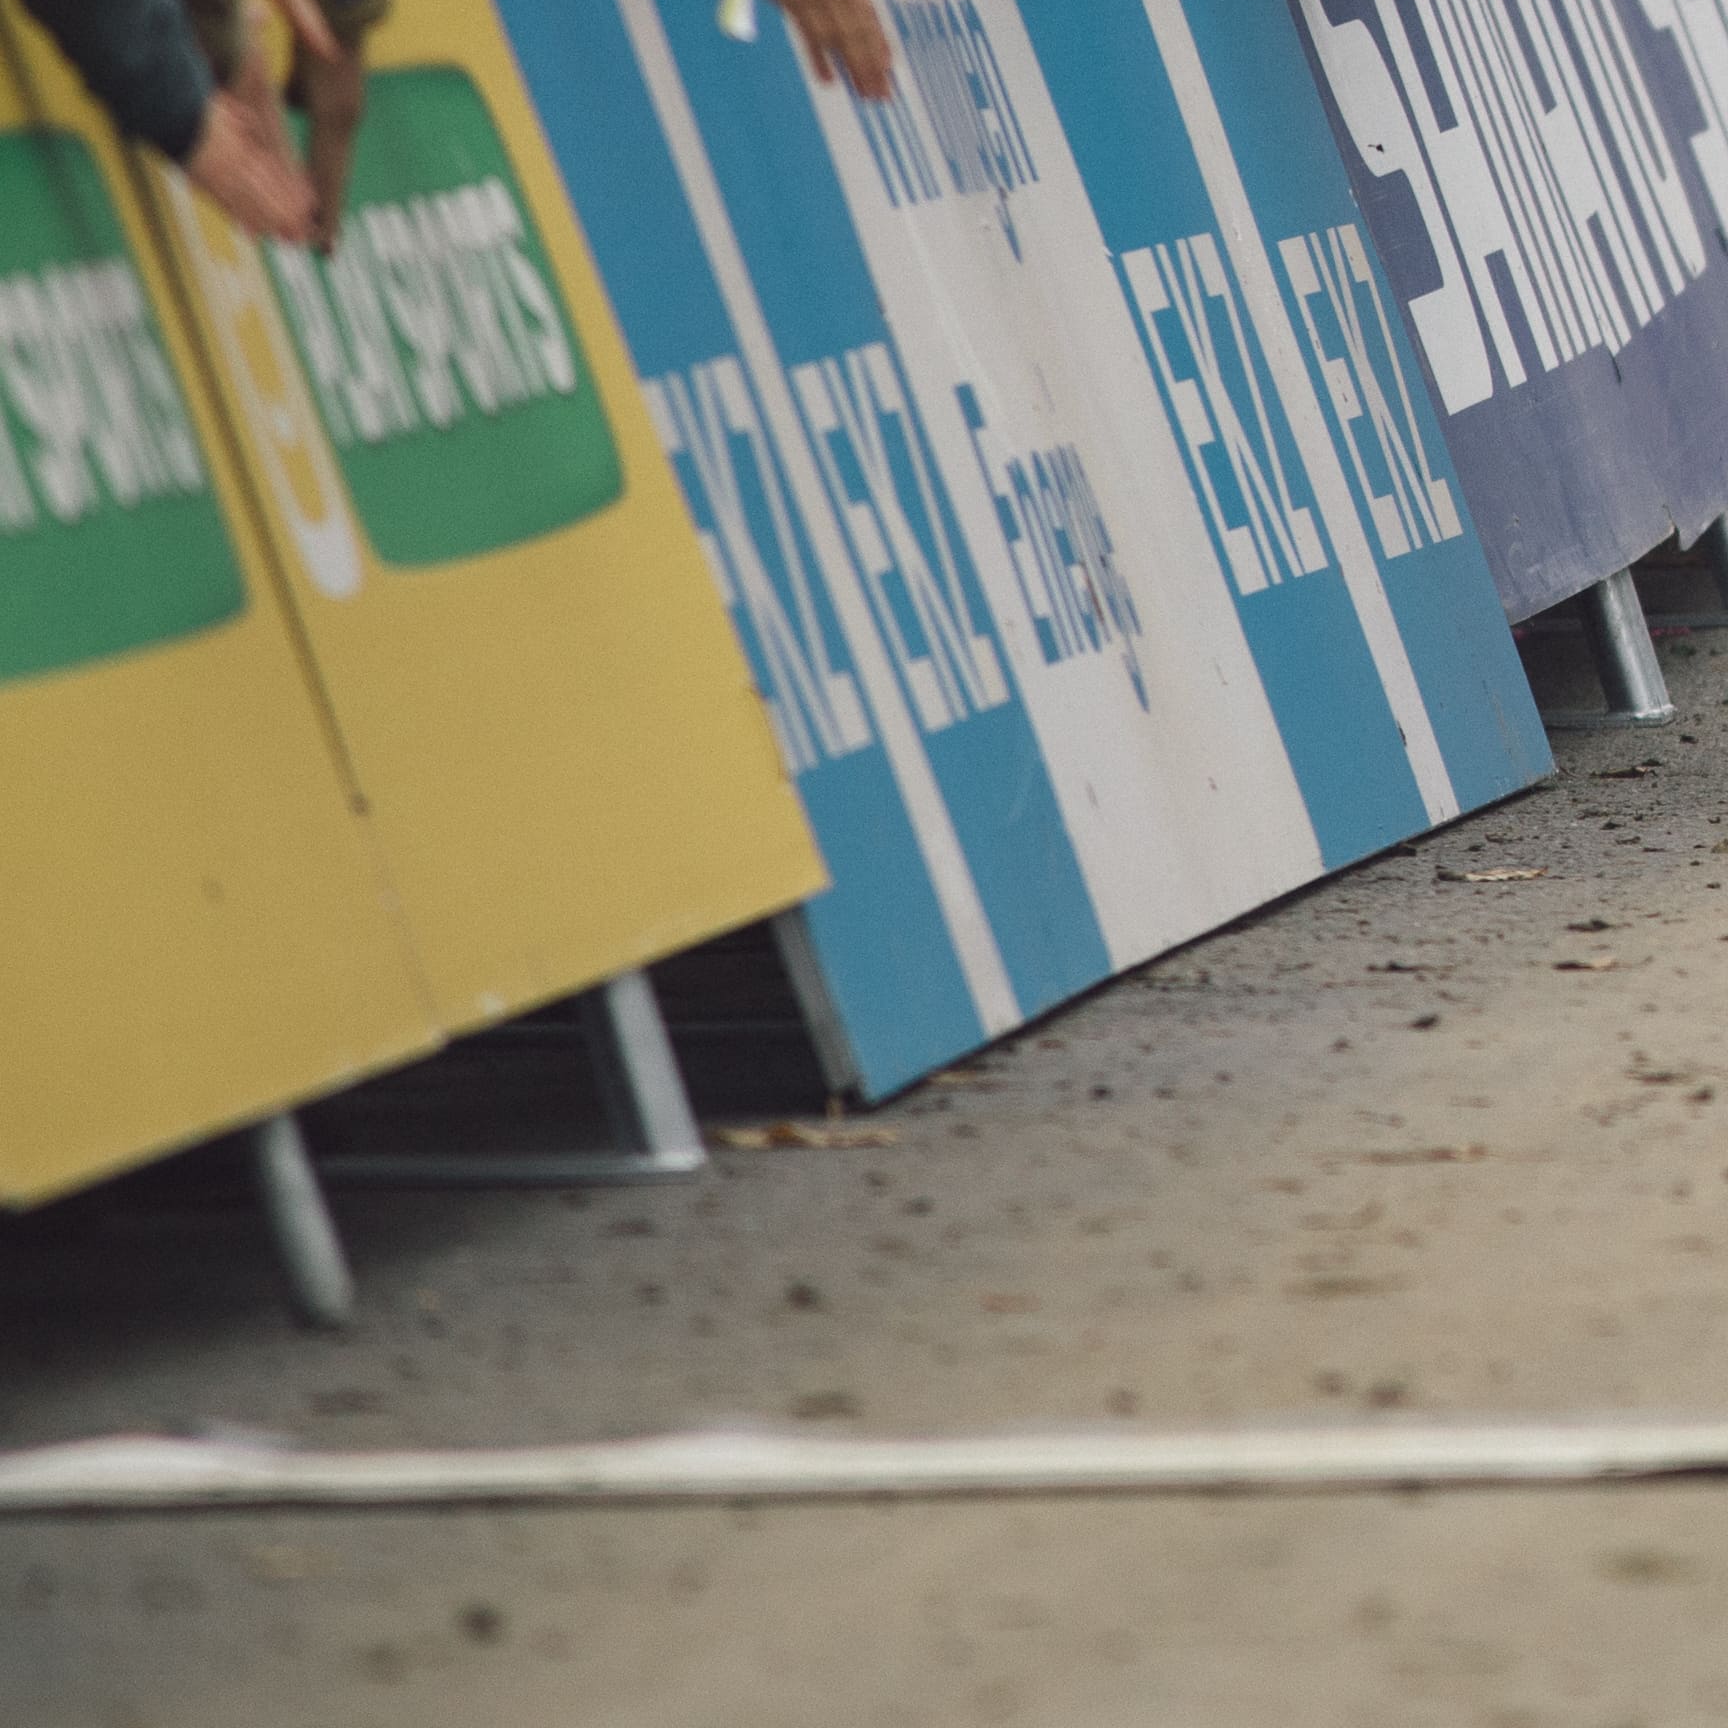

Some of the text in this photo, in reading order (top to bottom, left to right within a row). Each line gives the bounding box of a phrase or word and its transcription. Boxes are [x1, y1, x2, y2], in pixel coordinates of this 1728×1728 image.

[638, 355, 873, 776] EKZ
[790, 341, 1010, 733] EKZ
[1119, 232, 1329, 597] EKZ
[1276, 223, 1464, 559] EKZ
